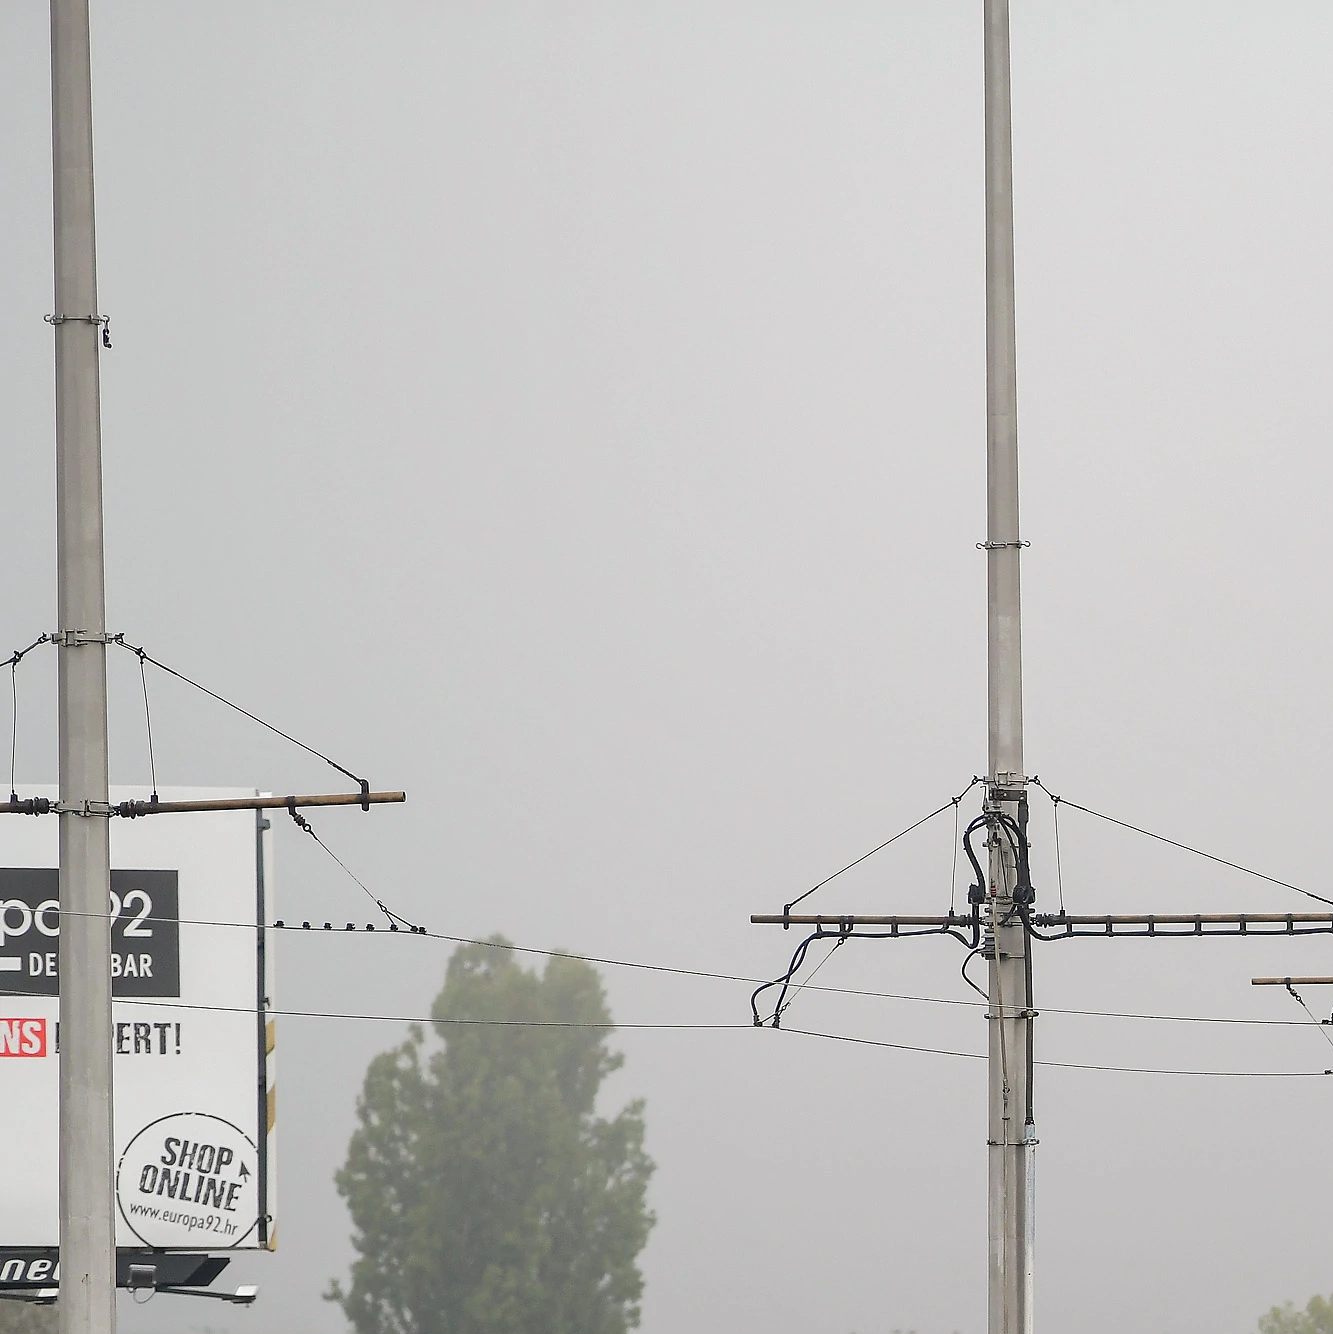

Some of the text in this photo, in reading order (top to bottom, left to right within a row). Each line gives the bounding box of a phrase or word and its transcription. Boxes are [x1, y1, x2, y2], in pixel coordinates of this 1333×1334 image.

[160, 1137, 234, 1175] SHOP
[138, 1164, 243, 1212] ONLINE
[130, 1203, 239, 1236] www.europa92.hr
